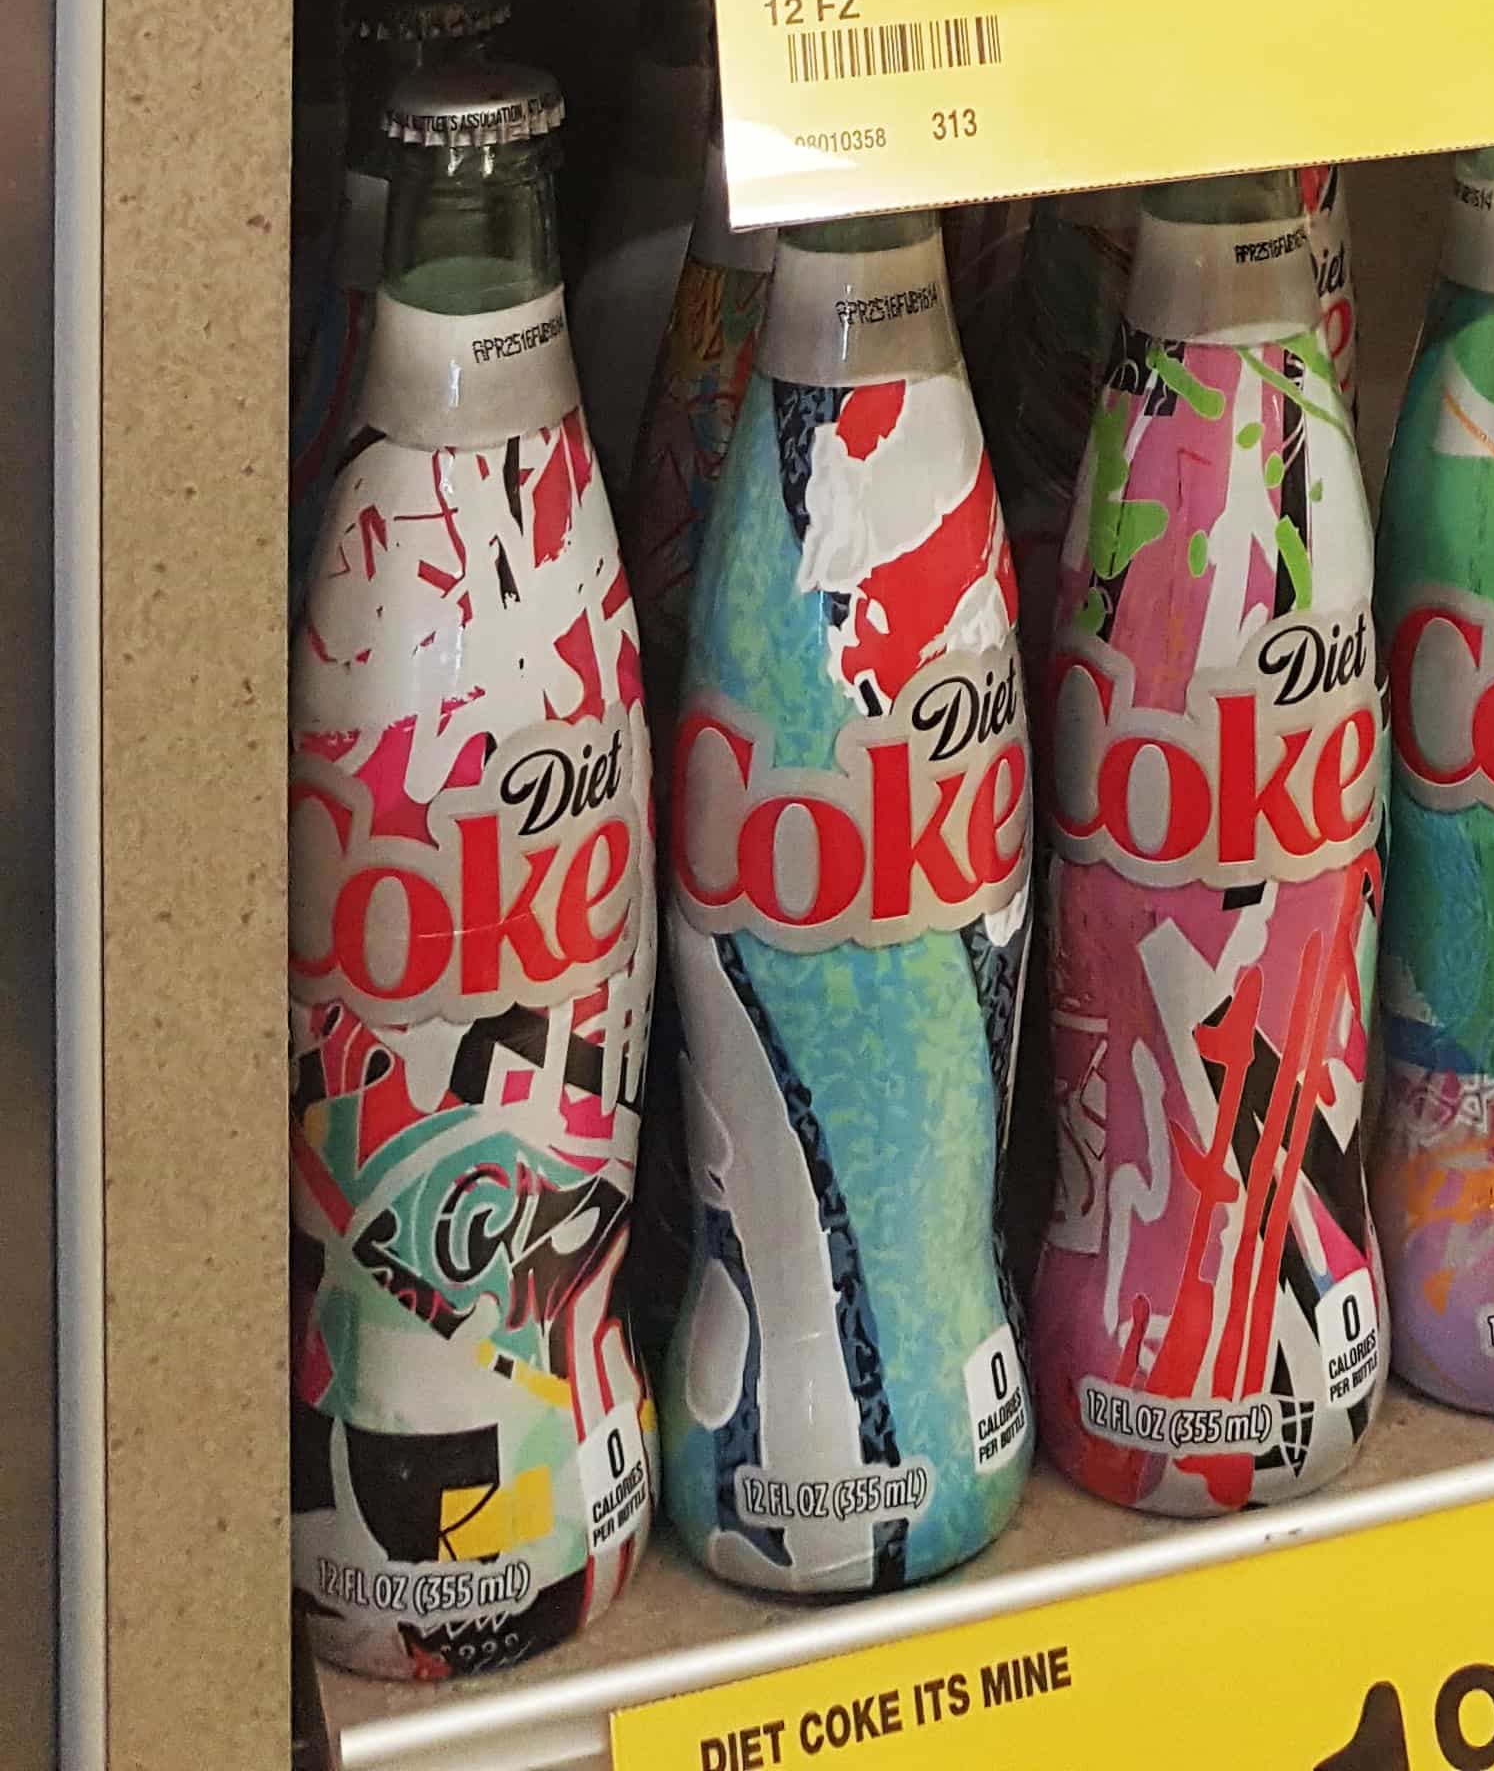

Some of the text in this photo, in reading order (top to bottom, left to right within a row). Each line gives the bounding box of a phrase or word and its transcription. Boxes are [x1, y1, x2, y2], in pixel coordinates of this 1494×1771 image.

[932, 108, 977, 141] 313
[1260, 614, 1367, 706] Diet
[912, 667, 1017, 760] Diet
[500, 731, 622, 835] Diet
[1052, 656, 1377, 864] Coke
[673, 713, 1025, 924] Coke
[290, 783, 632, 999] Coke
[1342, 1294, 1361, 1342] 0
[991, 1352, 1008, 1400] 0
[1328, 1329, 1377, 1380] CALORIES
[978, 1387, 1022, 1441] CALORIES
[1087, 1389, 1272, 1447] 12 FL OZ (355 mL)
[1329, 1378, 1350, 1404] PER
[607, 1428, 625, 1479] 0
[978, 1440, 998, 1464] PER
[592, 1461, 644, 1523] CALORIES
[743, 1466, 927, 1520] 12 FL OZ (355 mL)
[592, 1522, 613, 1547] PER
[319, 1559, 531, 1615] 12 FL OZ (355 mL)
[700, 1646, 1073, 1771] DIET COKE ITS MINE
